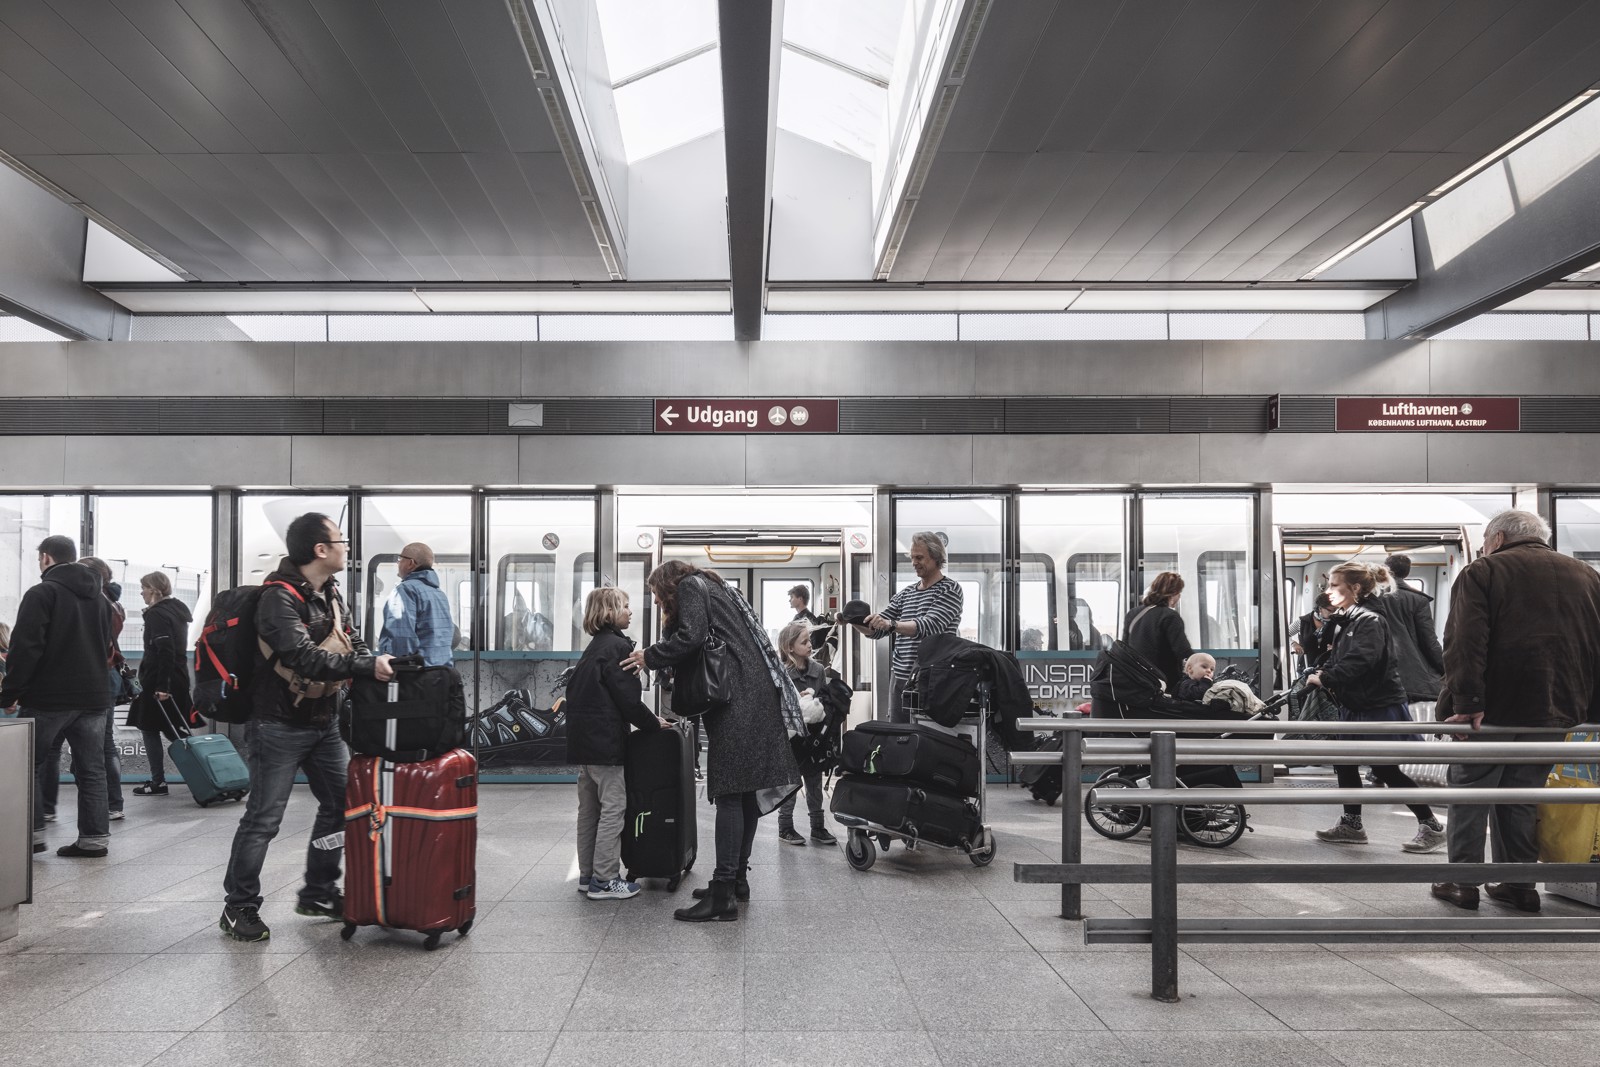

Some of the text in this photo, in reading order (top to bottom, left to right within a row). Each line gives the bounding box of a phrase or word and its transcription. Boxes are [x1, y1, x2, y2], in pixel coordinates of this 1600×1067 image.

[1271, 406, 1276, 419] 1
[1382, 402, 1458, 415] Lufthavnen
[687, 405, 758, 427] Udgang
[1368, 419, 1487, 427] KØBENHAVNS LUFTHAVN, KASTRUP
